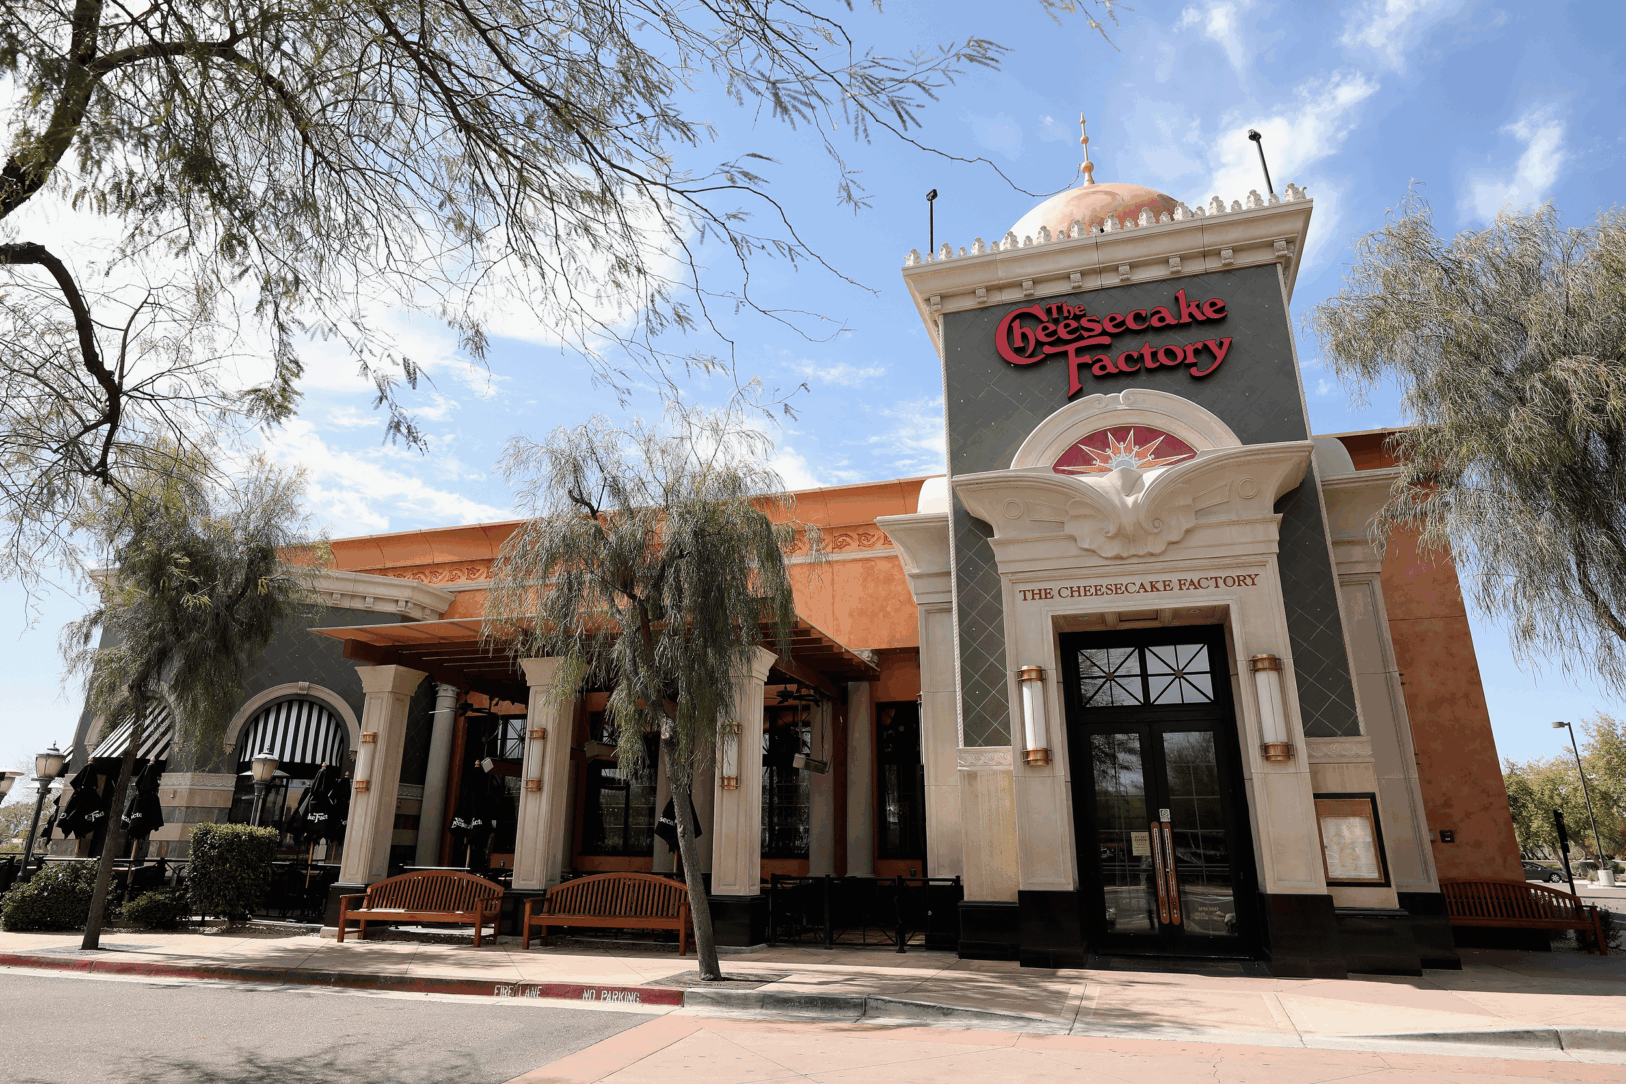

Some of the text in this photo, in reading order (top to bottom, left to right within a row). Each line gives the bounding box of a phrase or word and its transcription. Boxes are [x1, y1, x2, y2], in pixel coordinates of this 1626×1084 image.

[1046, 302, 1086, 319] The
[995, 288, 1228, 365] Cheesecake
[1043, 335, 1233, 397] Factory
[1019, 573, 1260, 601] THE CHEESECAKE FACTORY
[494, 984, 514, 998] FIRE
[582, 988, 640, 1004] NO PARKING
